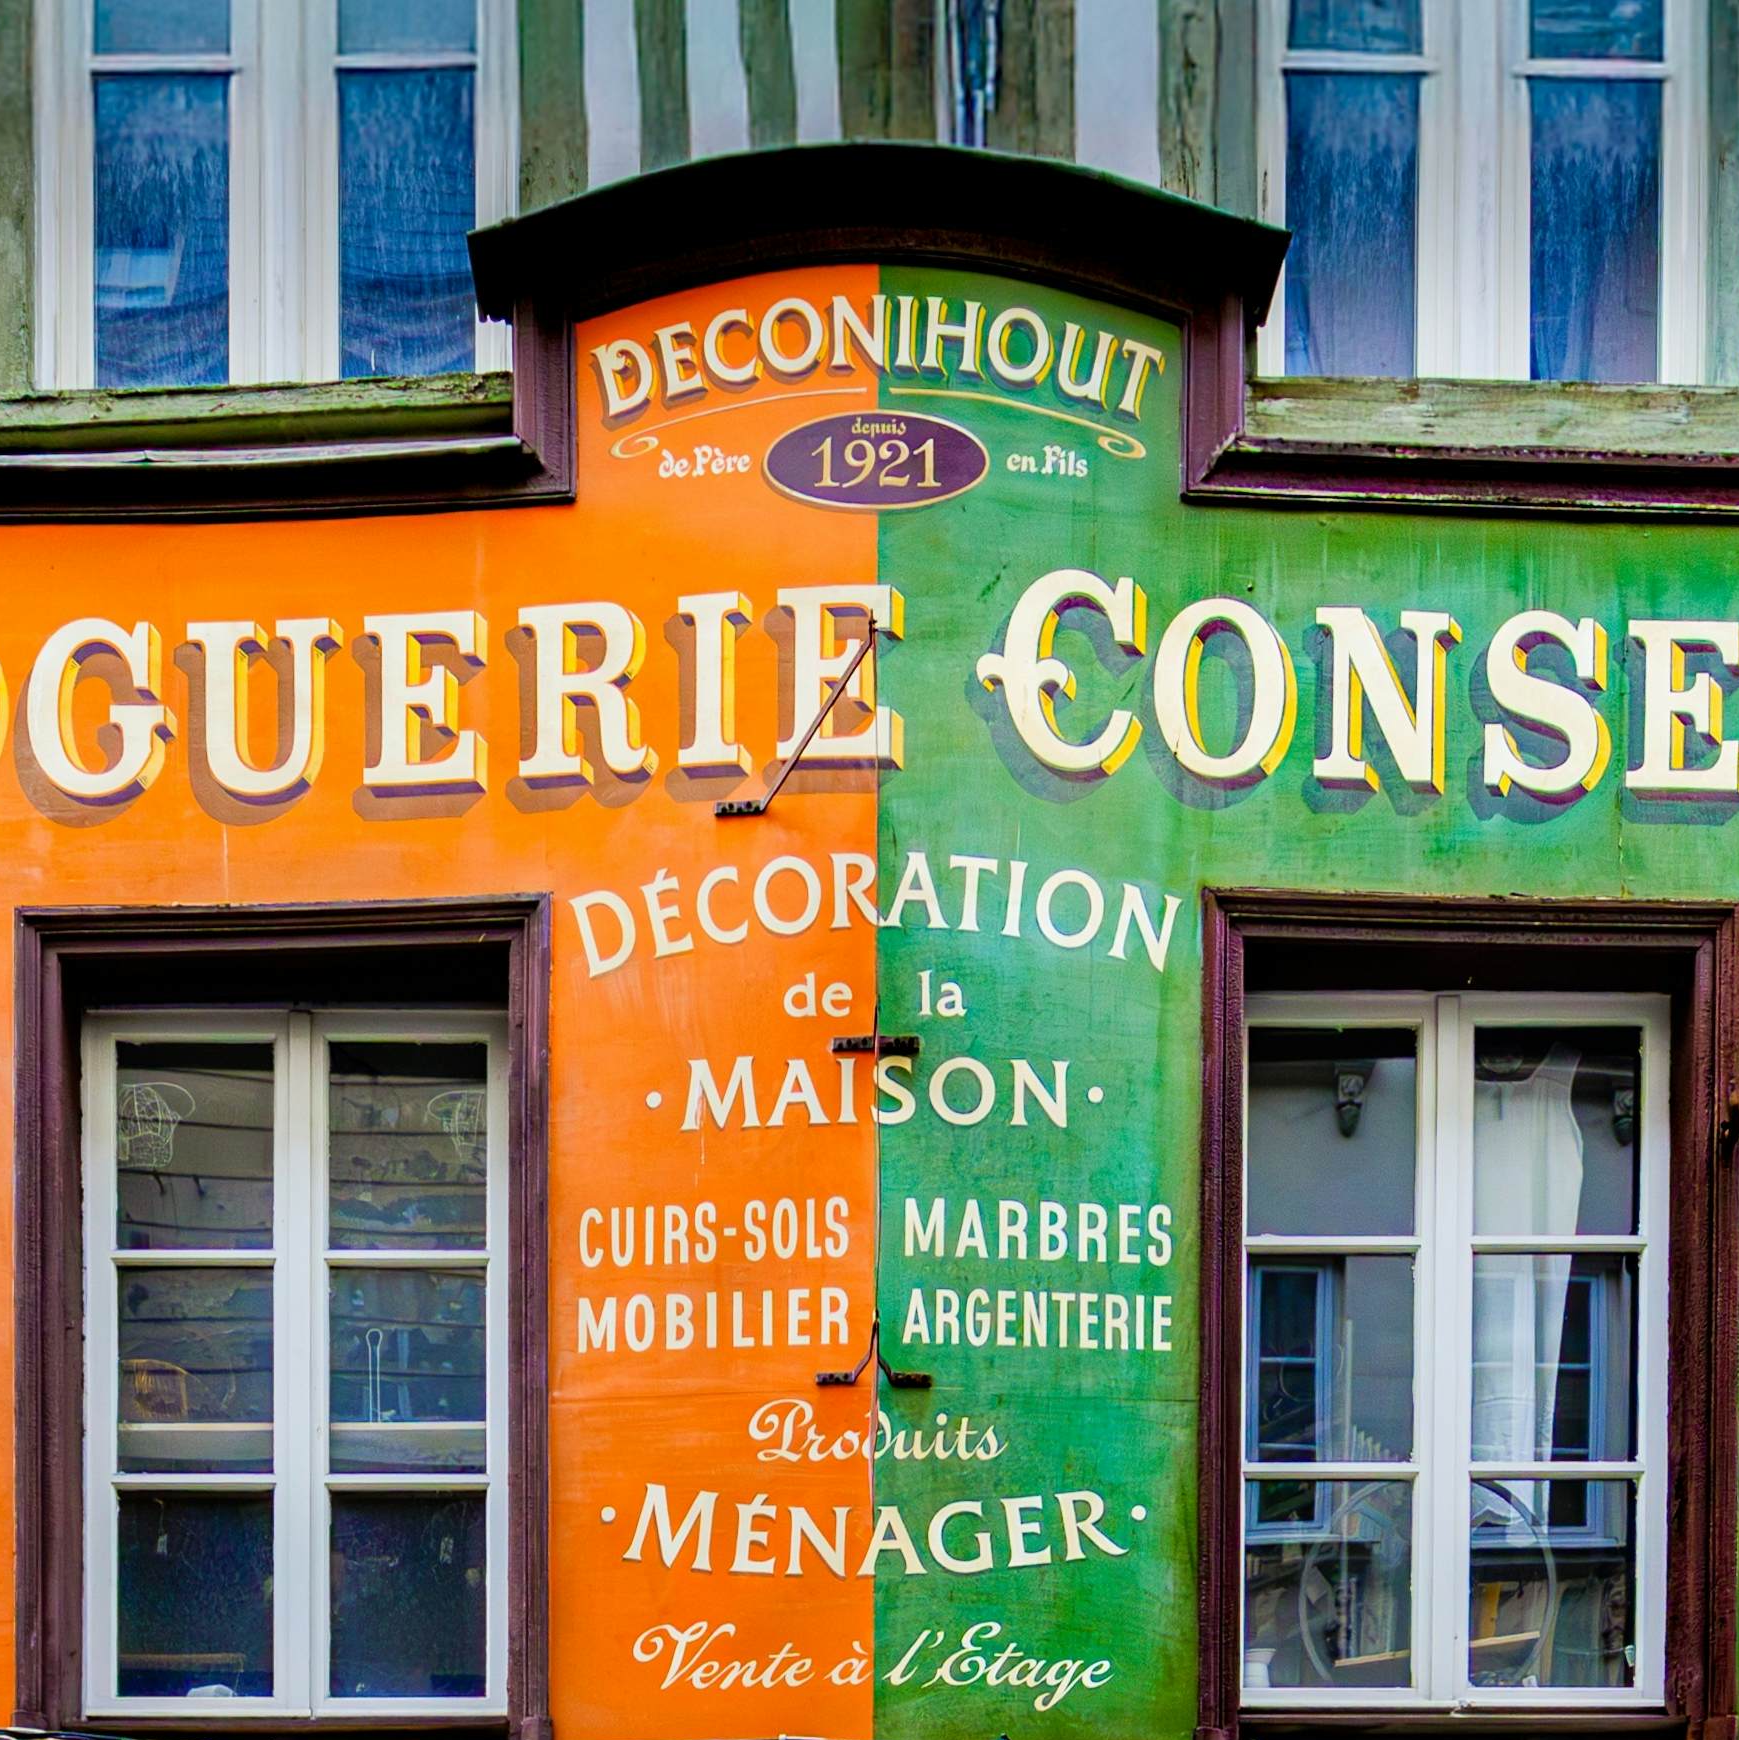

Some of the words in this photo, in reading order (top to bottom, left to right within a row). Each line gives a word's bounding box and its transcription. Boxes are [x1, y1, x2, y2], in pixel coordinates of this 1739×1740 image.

[591, 294, 1165, 420] DECONIHOUT
[851, 416, 907, 438] depuis
[659, 448, 690, 478] de
[692, 445, 752, 477] Père
[811, 439, 943, 488] 1921
[1007, 455, 1038, 474] en
[1040, 445, 1088, 477] Fils
[569, 851, 1183, 979] DÉCORATION
[783, 971, 852, 1019] de
[919, 969, 967, 1018] la
[680, 1054, 1071, 1131] MAISON
[578, 1196, 850, 1268] CUIRS-SOLS
[904, 1197, 1174, 1267] MARBRES
[577, 1287, 850, 1354] MOBILIER
[902, 1288, 1173, 1352] ARGENTERIE
[748, 1398, 1009, 1462] Produits
[621, 1482, 1130, 1578] MÉNAGER
[632, 1620, 815, 1690] Vente
[823, 1641, 871, 1687] à
